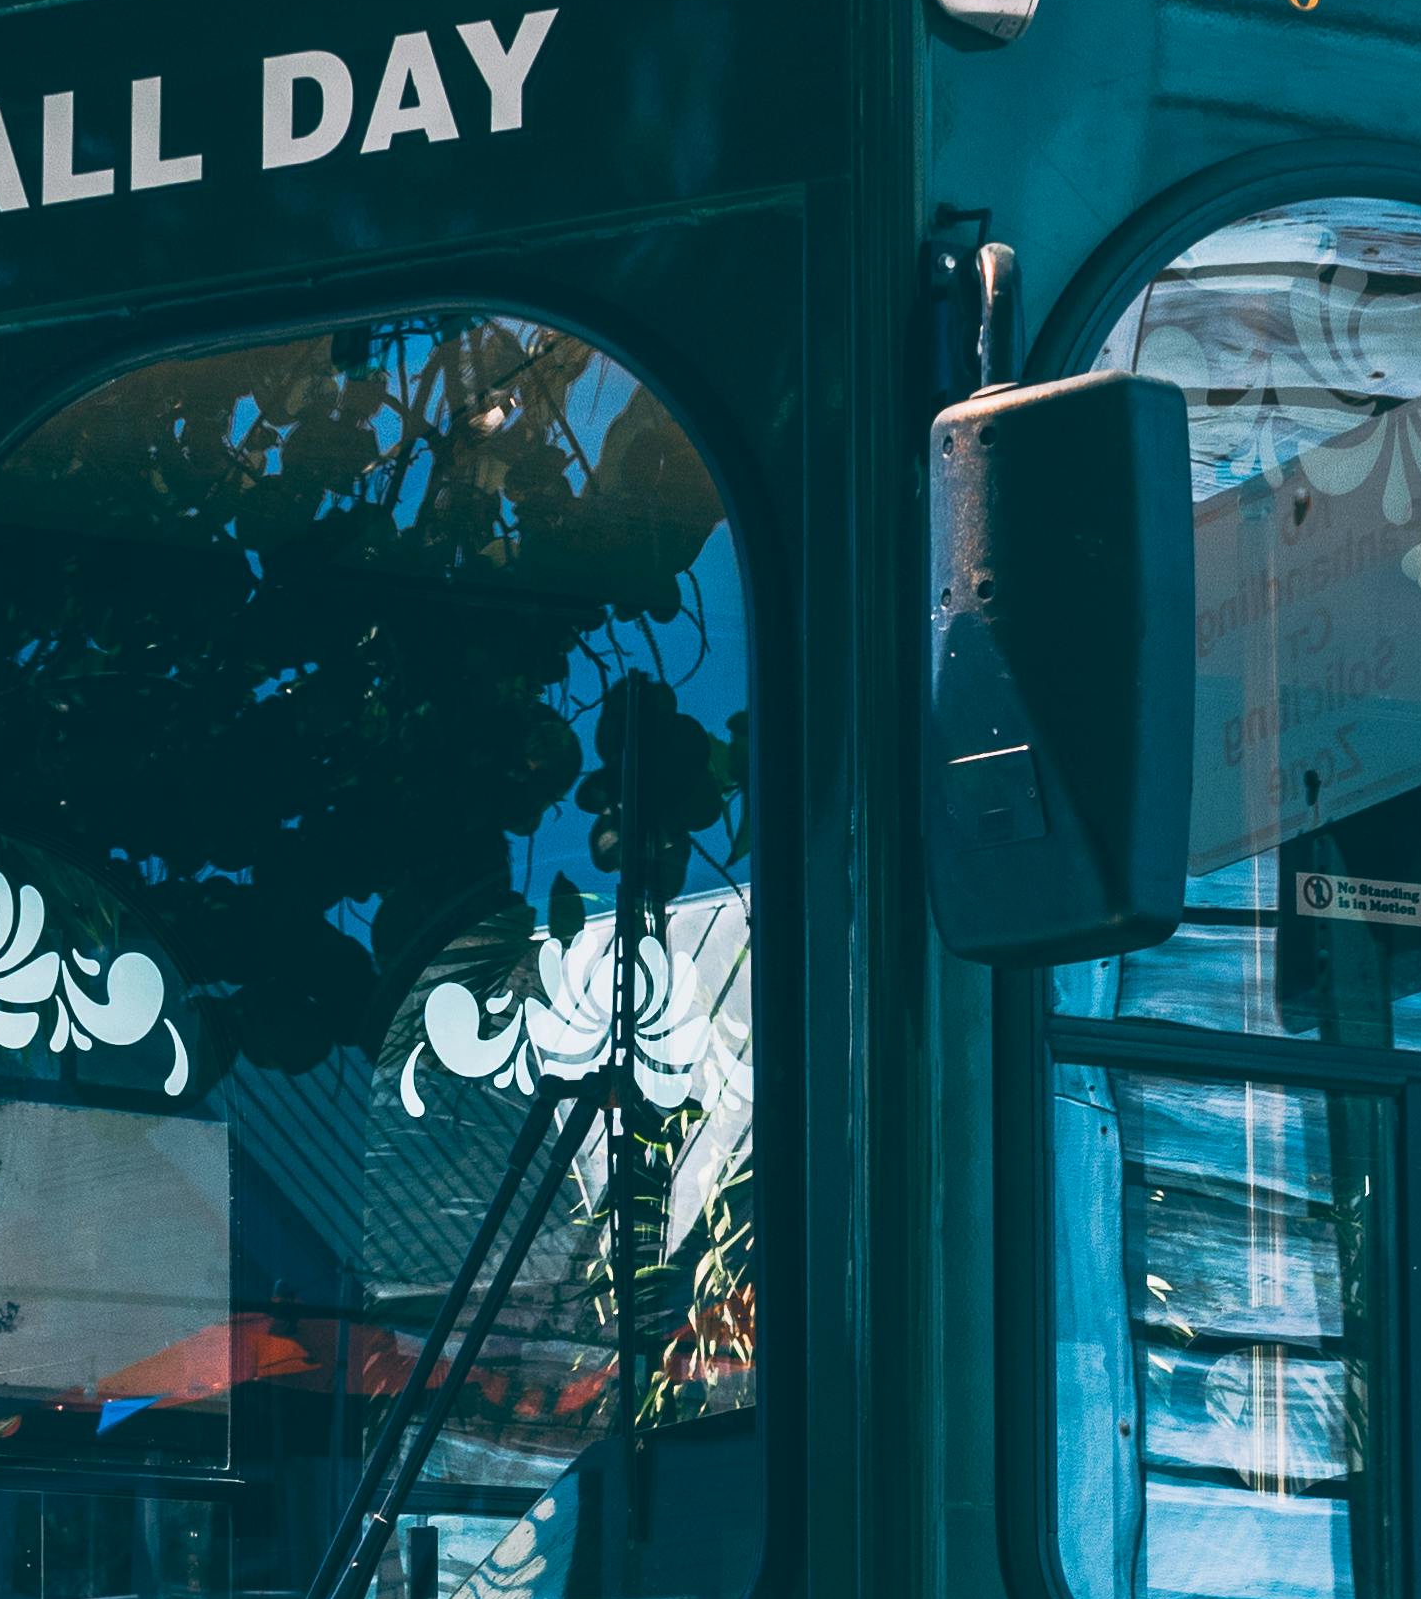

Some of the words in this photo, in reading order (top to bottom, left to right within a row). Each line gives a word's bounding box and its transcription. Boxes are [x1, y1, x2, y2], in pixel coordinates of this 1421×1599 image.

[261, 7, 561, 171] DAY
[1337, 881, 1357, 895] No
[1359, 882, 1420, 903] Standing
[1339, 897, 1349, 909] is
[1353, 898, 1366, 910] in
[1369, 900, 1417, 916] Motion
